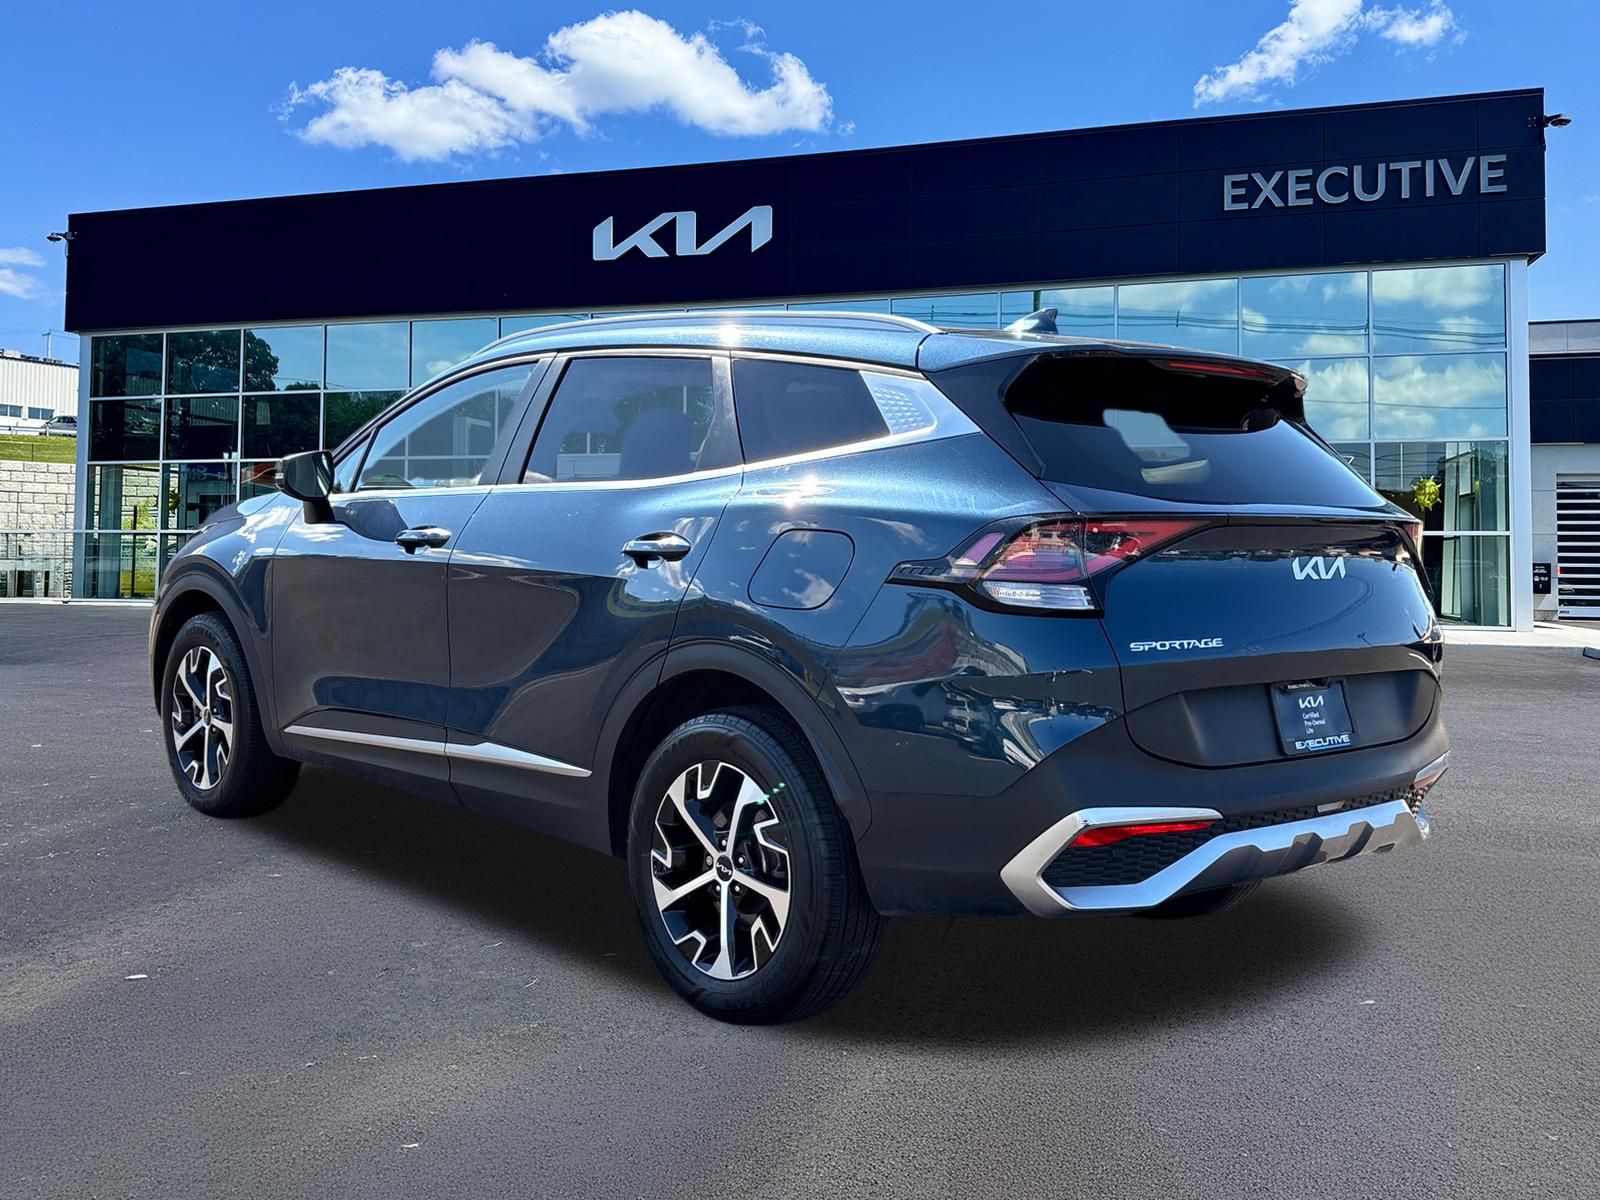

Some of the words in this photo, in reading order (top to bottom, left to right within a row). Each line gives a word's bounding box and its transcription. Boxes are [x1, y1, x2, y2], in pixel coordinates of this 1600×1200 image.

[1223, 154, 1508, 212] EXECUTIVE
[593, 205, 773, 261] KIA
[1292, 556, 1347, 581] KIA
[1129, 637, 1224, 653] SPORTAGE
[1298, 695, 1324, 709] KIA
[1295, 735, 1350, 750] EXECUTIVE
